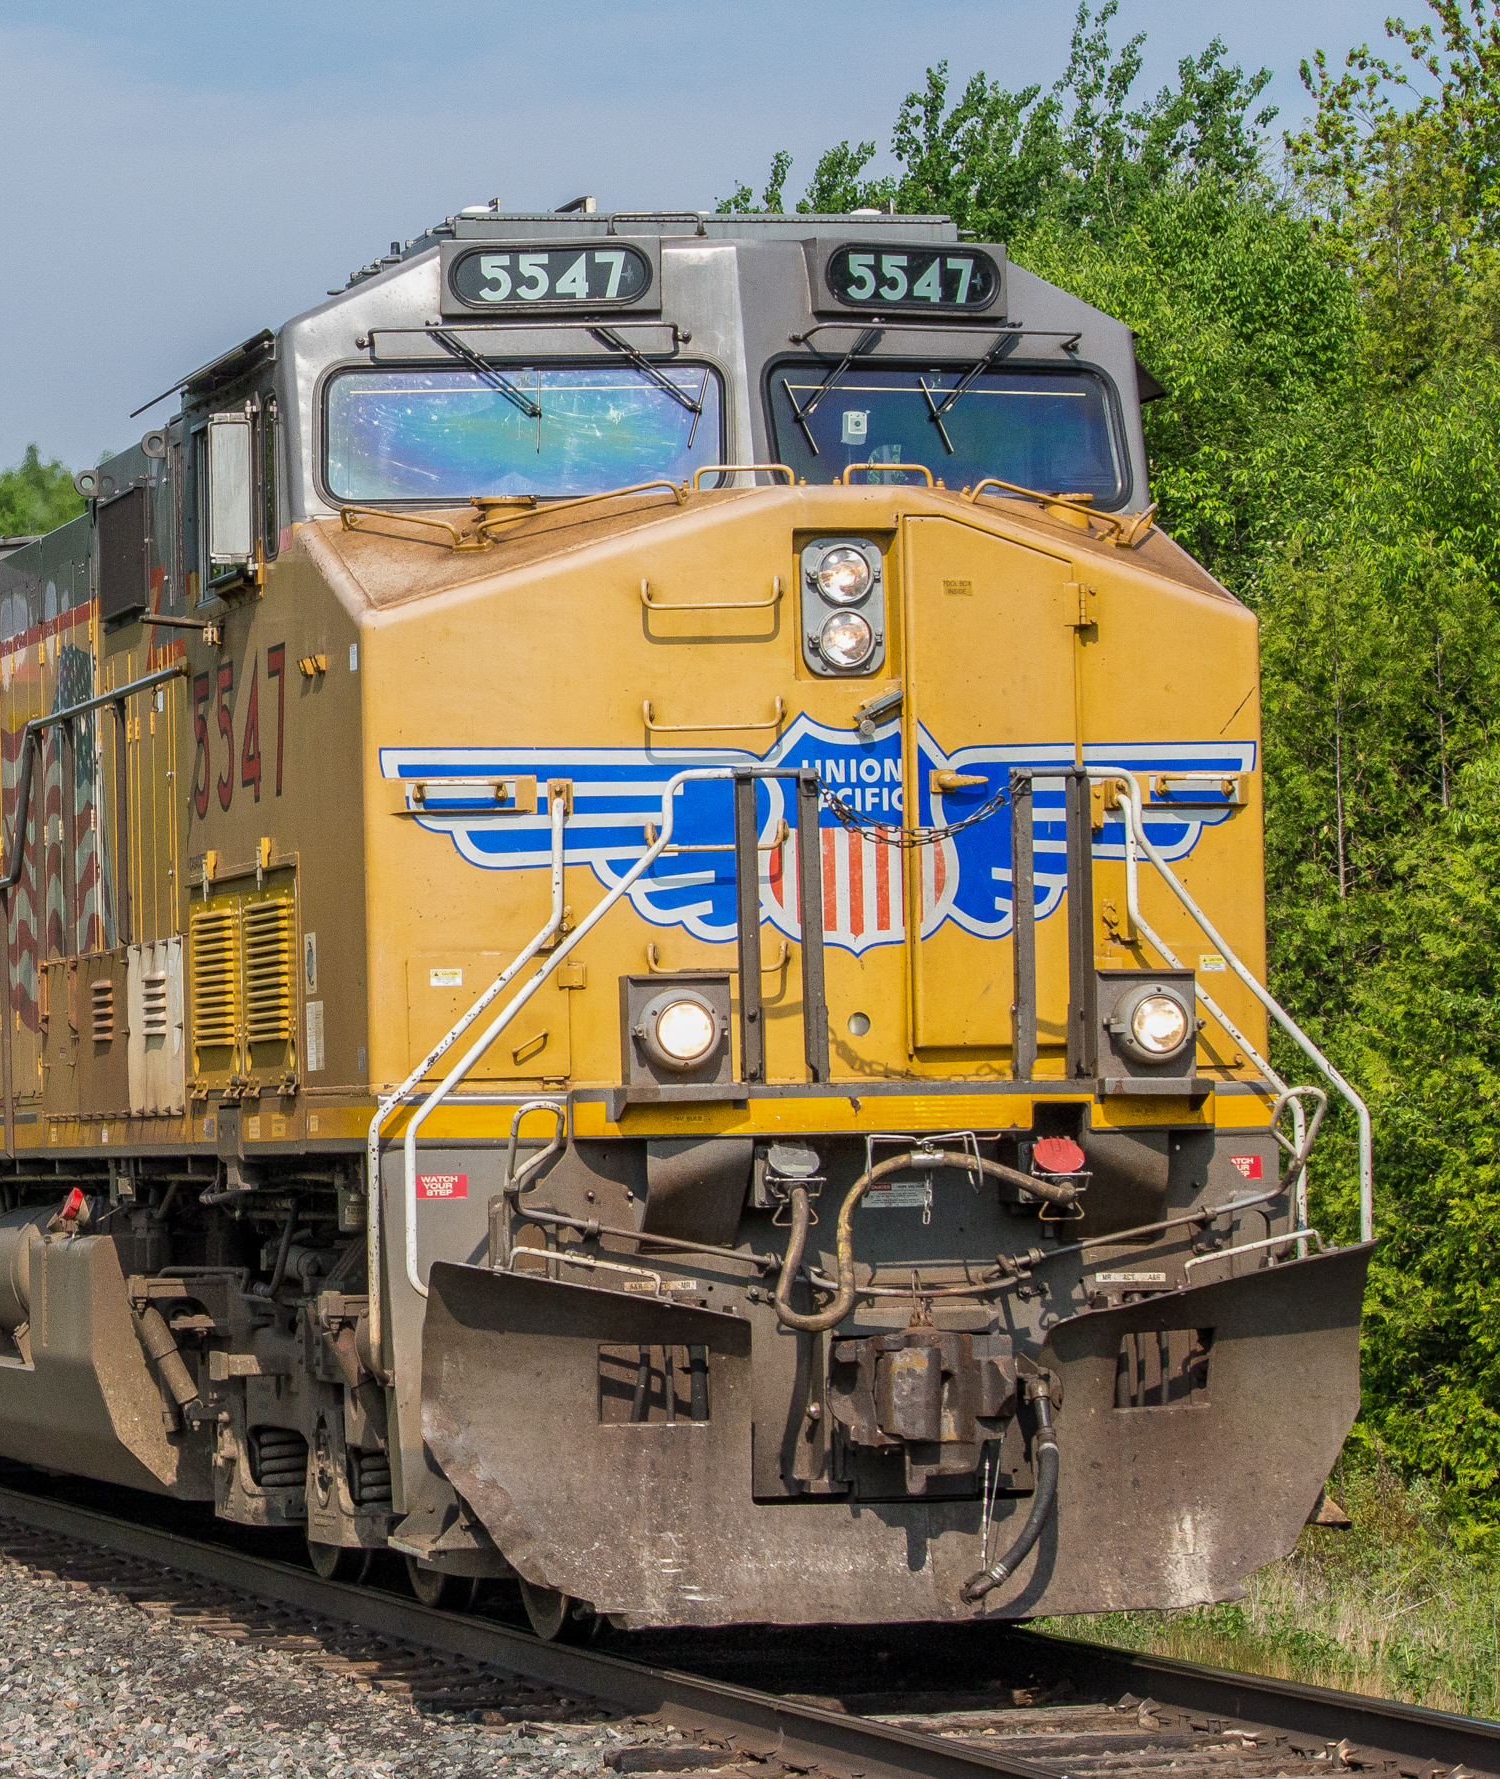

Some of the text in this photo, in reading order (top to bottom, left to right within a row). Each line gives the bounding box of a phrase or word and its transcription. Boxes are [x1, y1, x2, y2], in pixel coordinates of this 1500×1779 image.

[479, 251, 625, 301] 5547
[847, 254, 974, 303] 5547
[194, 641, 286, 821] 5547
[818, 787, 903, 812] ACIFIC
[420, 1175, 458, 1183] WATCH
[423, 1182, 453, 1190] YOUR
